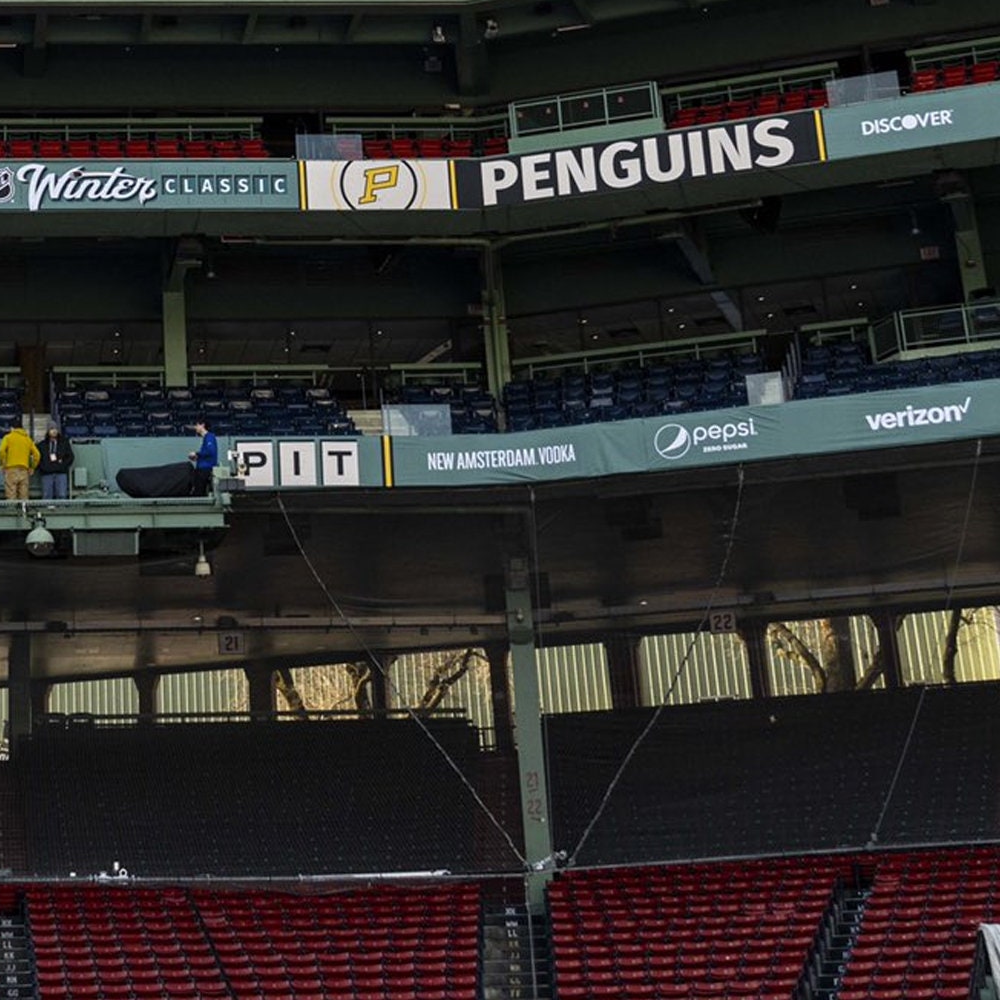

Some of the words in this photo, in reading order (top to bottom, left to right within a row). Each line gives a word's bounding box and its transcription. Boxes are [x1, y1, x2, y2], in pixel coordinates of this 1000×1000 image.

[861, 109, 953, 135] DISCOVER
[480, 118, 795, 206] PENGUINS
[17, 164, 156, 212] Winter
[164, 178, 286, 193] CLASSIC
[358, 164, 400, 205] P
[866, 405, 962, 430] verizon
[693, 417, 755, 445] pepsi
[427, 452, 454, 470] NEW
[457, 448, 535, 470] AMSTERDAM
[538, 444, 576, 465] VODKA
[703, 445, 722, 453] ZERO
[723, 443, 748, 451] SUGAR
[242, 451, 352, 476] PIT
[713, 614, 732, 630] 22
[225, 636, 238, 650] 21
